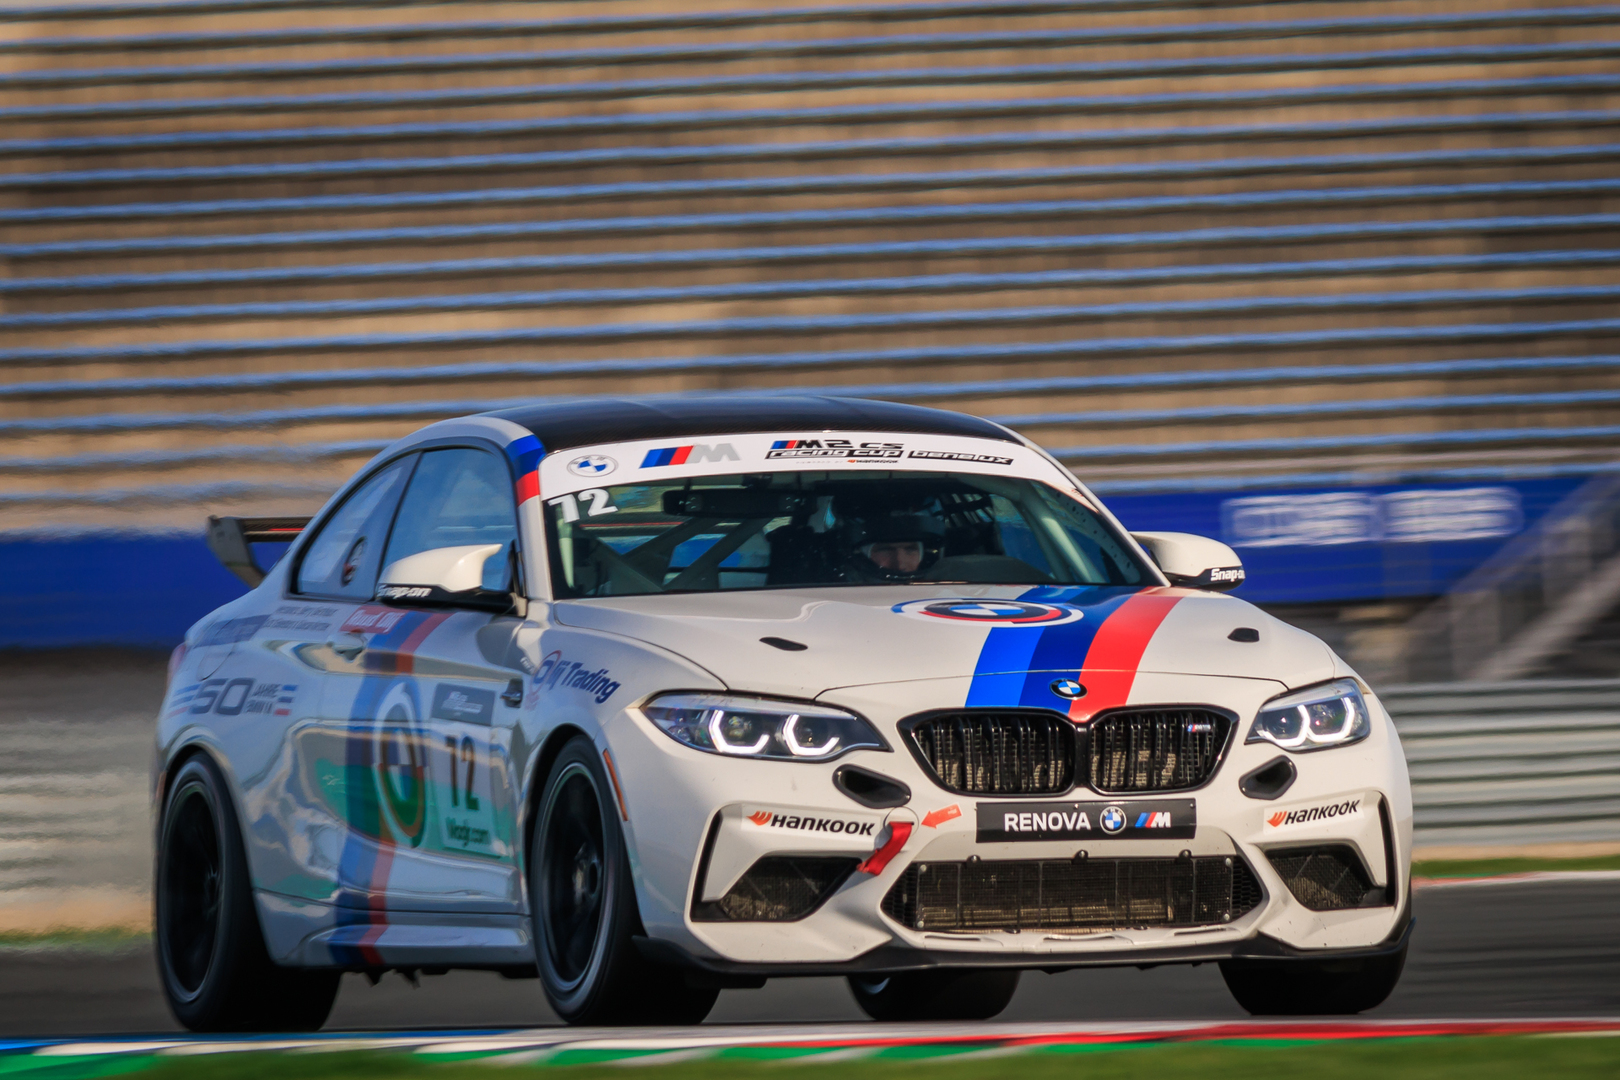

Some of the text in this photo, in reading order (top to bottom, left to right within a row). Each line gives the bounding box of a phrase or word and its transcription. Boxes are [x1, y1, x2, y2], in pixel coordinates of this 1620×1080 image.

[769, 449, 1010, 464] racing cup benelux
[795, 439, 853, 448] M2
[547, 488, 619, 524] 12
[192, 679, 254, 715] 50
[561, 661, 621, 705] Trading
[445, 735, 480, 810] 12
[1003, 812, 1091, 832] RENOVA
